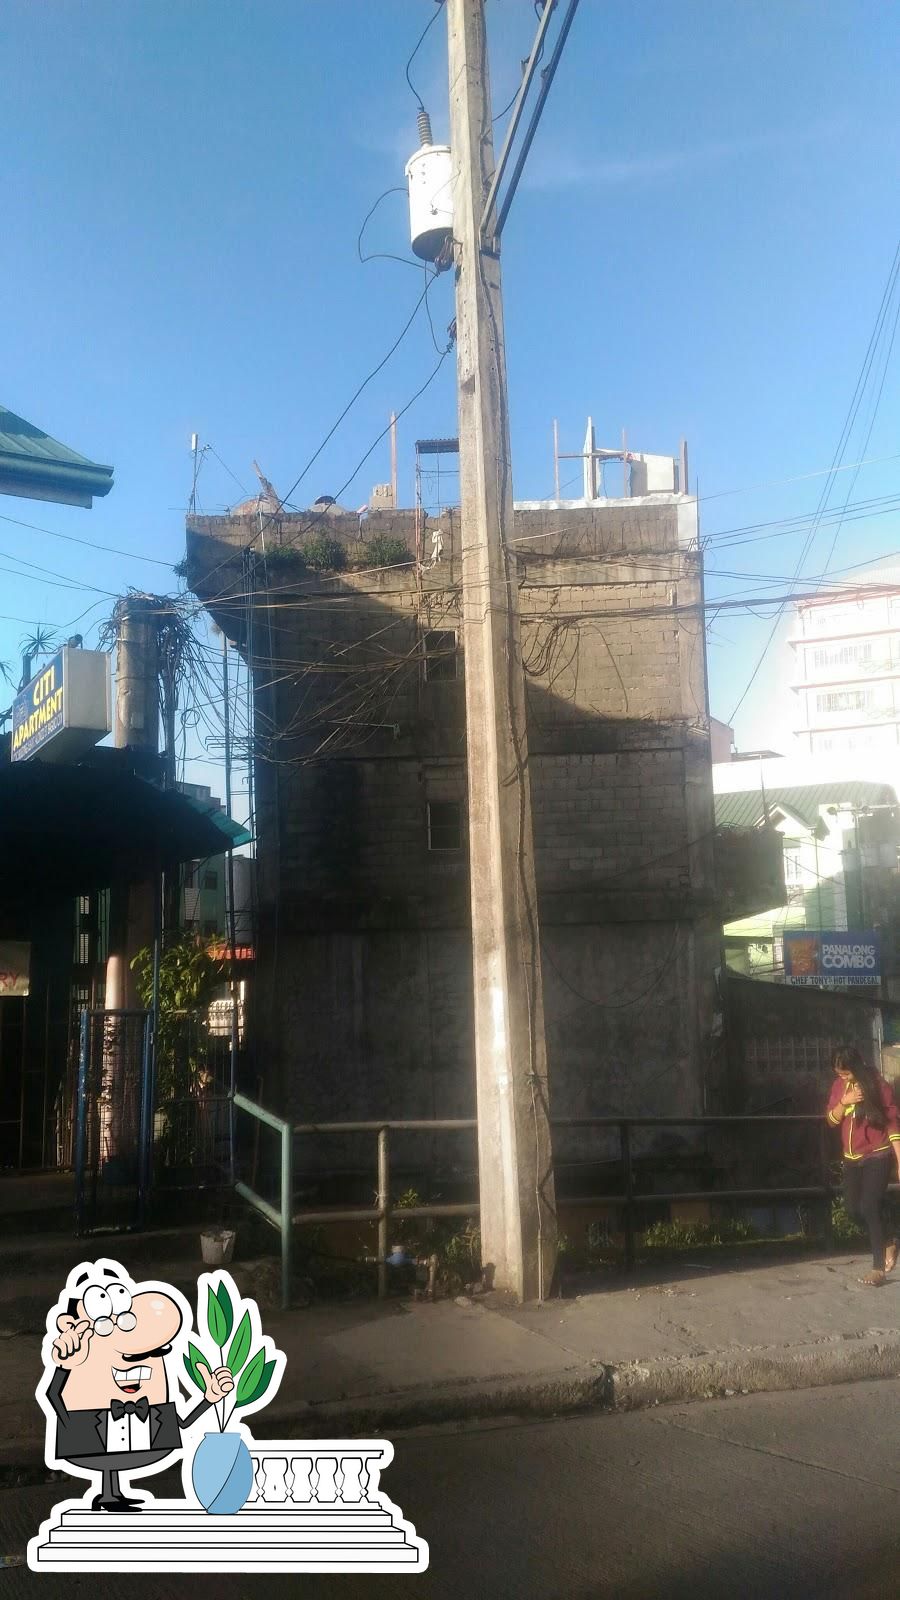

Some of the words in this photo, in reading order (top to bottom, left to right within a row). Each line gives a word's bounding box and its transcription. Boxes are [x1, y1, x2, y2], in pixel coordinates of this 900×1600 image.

[33, 665, 55, 706] CITI
[13, 687, 63, 751] APARTMENT
[822, 944, 875, 955] PANALONG
[822, 955, 875, 968] COMBO
[790, 976, 808, 985] CHEF
[833, 976, 847, 985] HOT
[847, 976, 879, 985] PANDESAL
